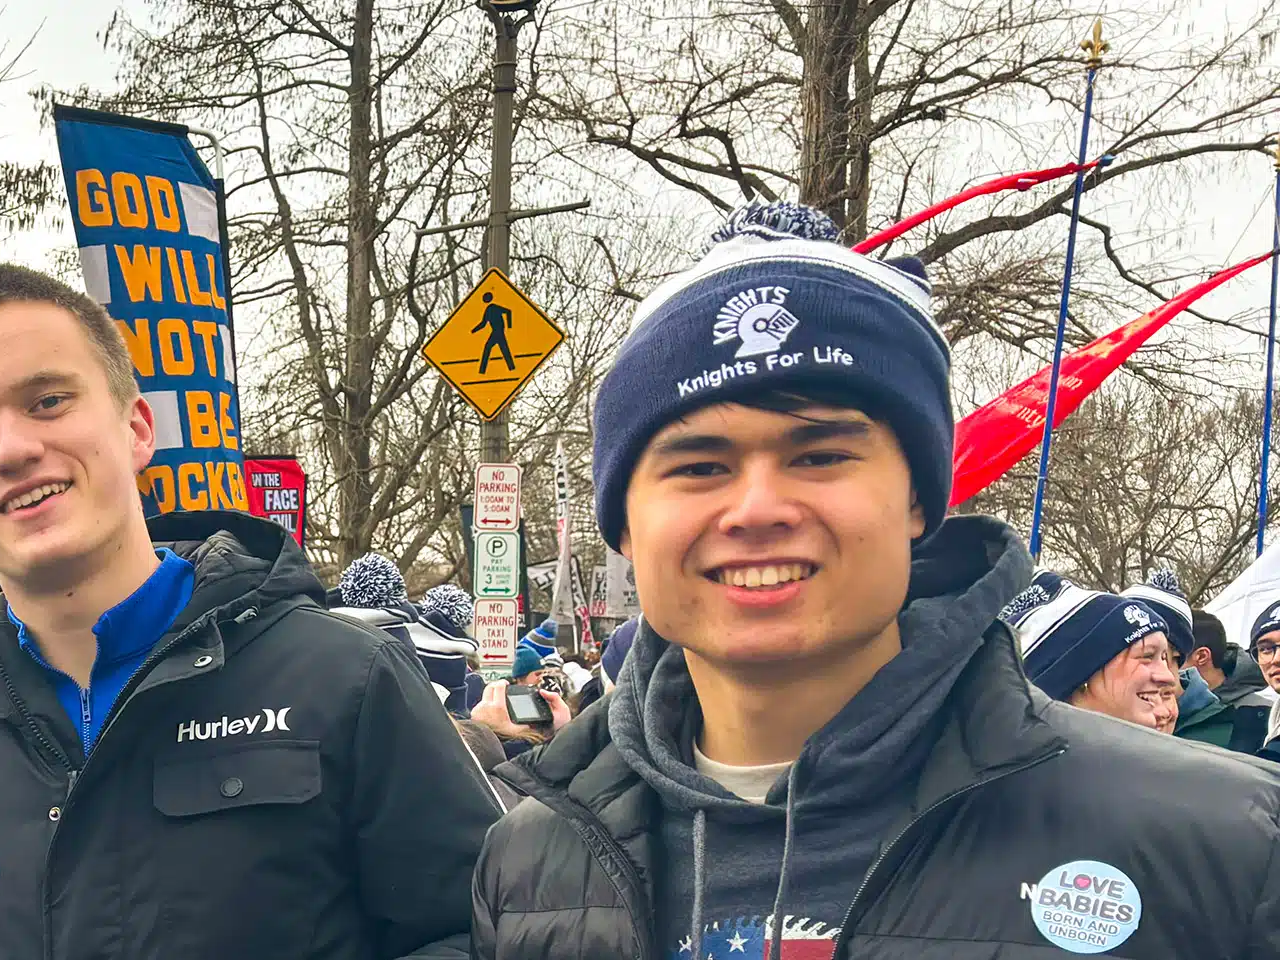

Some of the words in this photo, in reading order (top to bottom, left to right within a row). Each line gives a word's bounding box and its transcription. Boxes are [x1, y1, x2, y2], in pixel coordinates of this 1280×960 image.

[75, 168, 181, 232] GOD
[114, 244, 227, 310] WILL
[712, 285, 791, 346] KNIGHTS
[116, 318, 218, 378] NOT
[676, 359, 758, 397] Knights
[765, 352, 804, 371] For
[813, 346, 855, 366] Life
[185, 390, 238, 451] BE
[263, 473, 280, 487] THE
[492, 471, 504, 481] NO
[479, 483, 517, 492] PARKING
[265, 489, 299, 511] FACE
[492, 540, 503, 553] P
[485, 573, 492, 584] 3
[489, 603, 503, 614] NO
[477, 616, 514, 626] PARKING
[482, 640, 508, 648] STAND
[487, 629, 505, 638] TAXI
[177, 714, 261, 742] Hurley
[1059, 870, 1126, 899] LOVE
[1038, 888, 1133, 923] BABIES
[1042, 910, 1084, 928] BORN
[1087, 920, 1119, 935] AND
[1048, 924, 1108, 946] UNBORN
